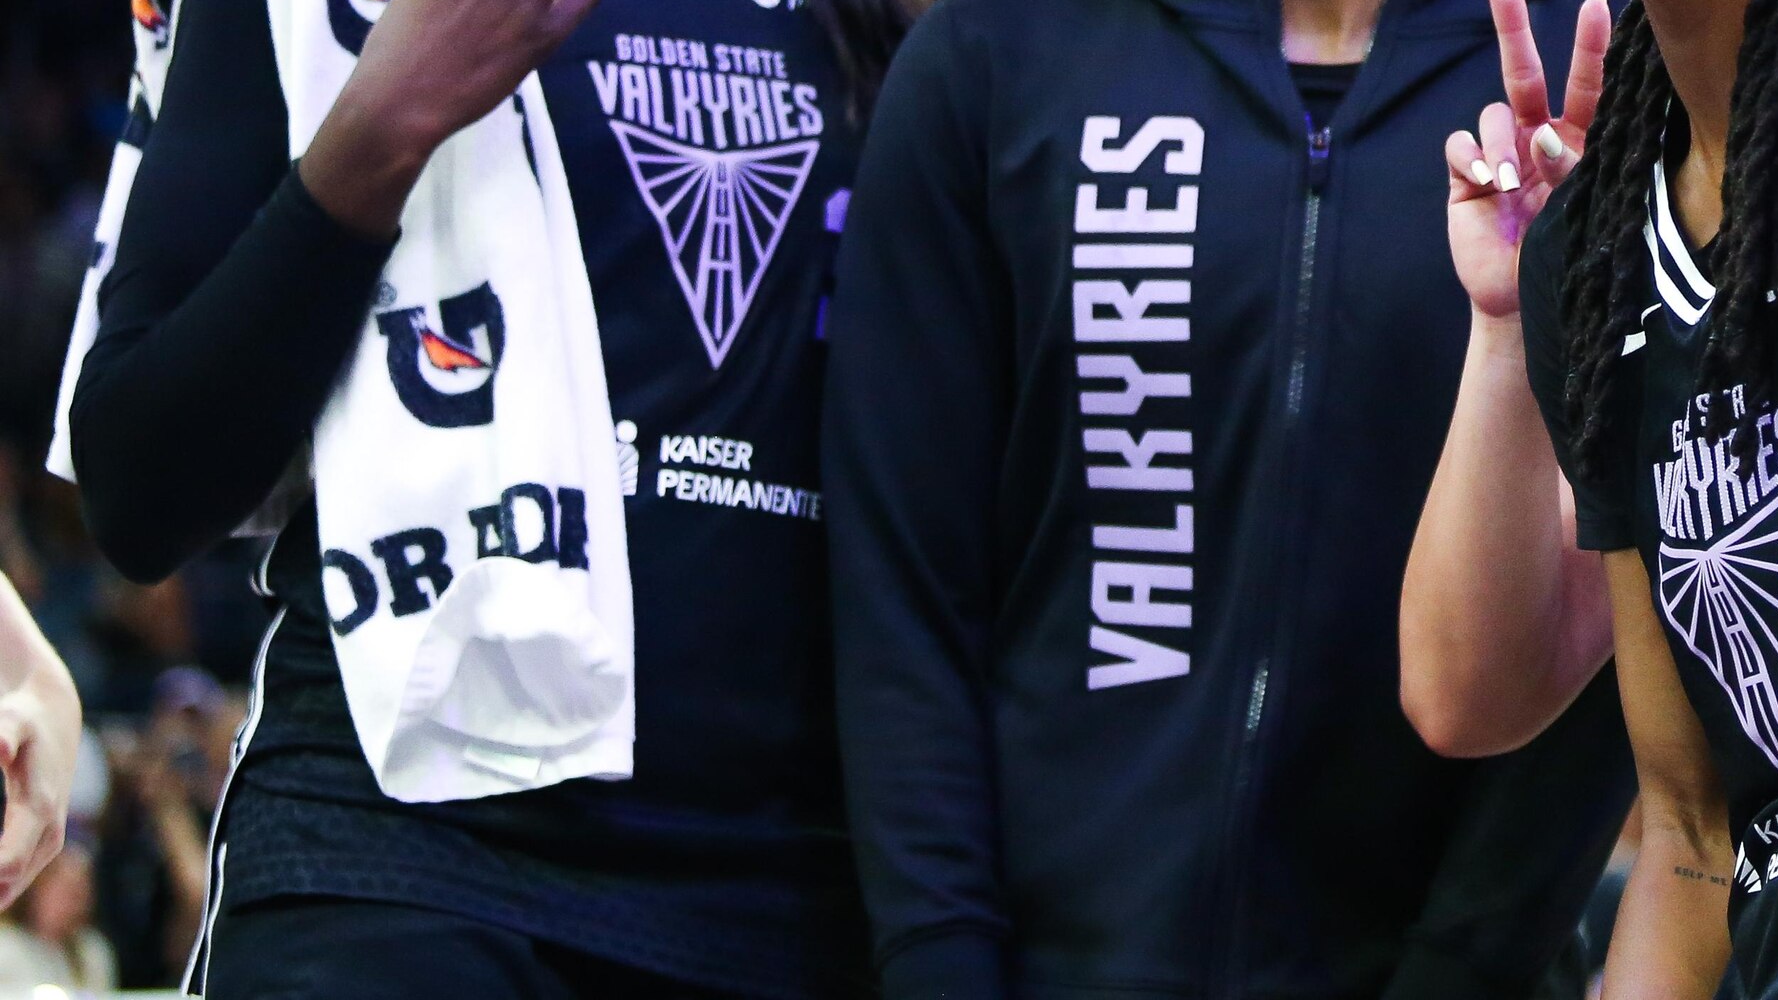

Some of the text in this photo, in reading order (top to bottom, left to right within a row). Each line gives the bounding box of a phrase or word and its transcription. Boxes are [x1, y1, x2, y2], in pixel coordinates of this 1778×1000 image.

[615, 32, 788, 79] GOLDEN STATE
[587, 60, 824, 150] VALKYRIES
[1072, 116, 1204, 690] VALKYRIES
[659, 434, 753, 472] KAISER
[656, 468, 823, 521] PERMANENTE
